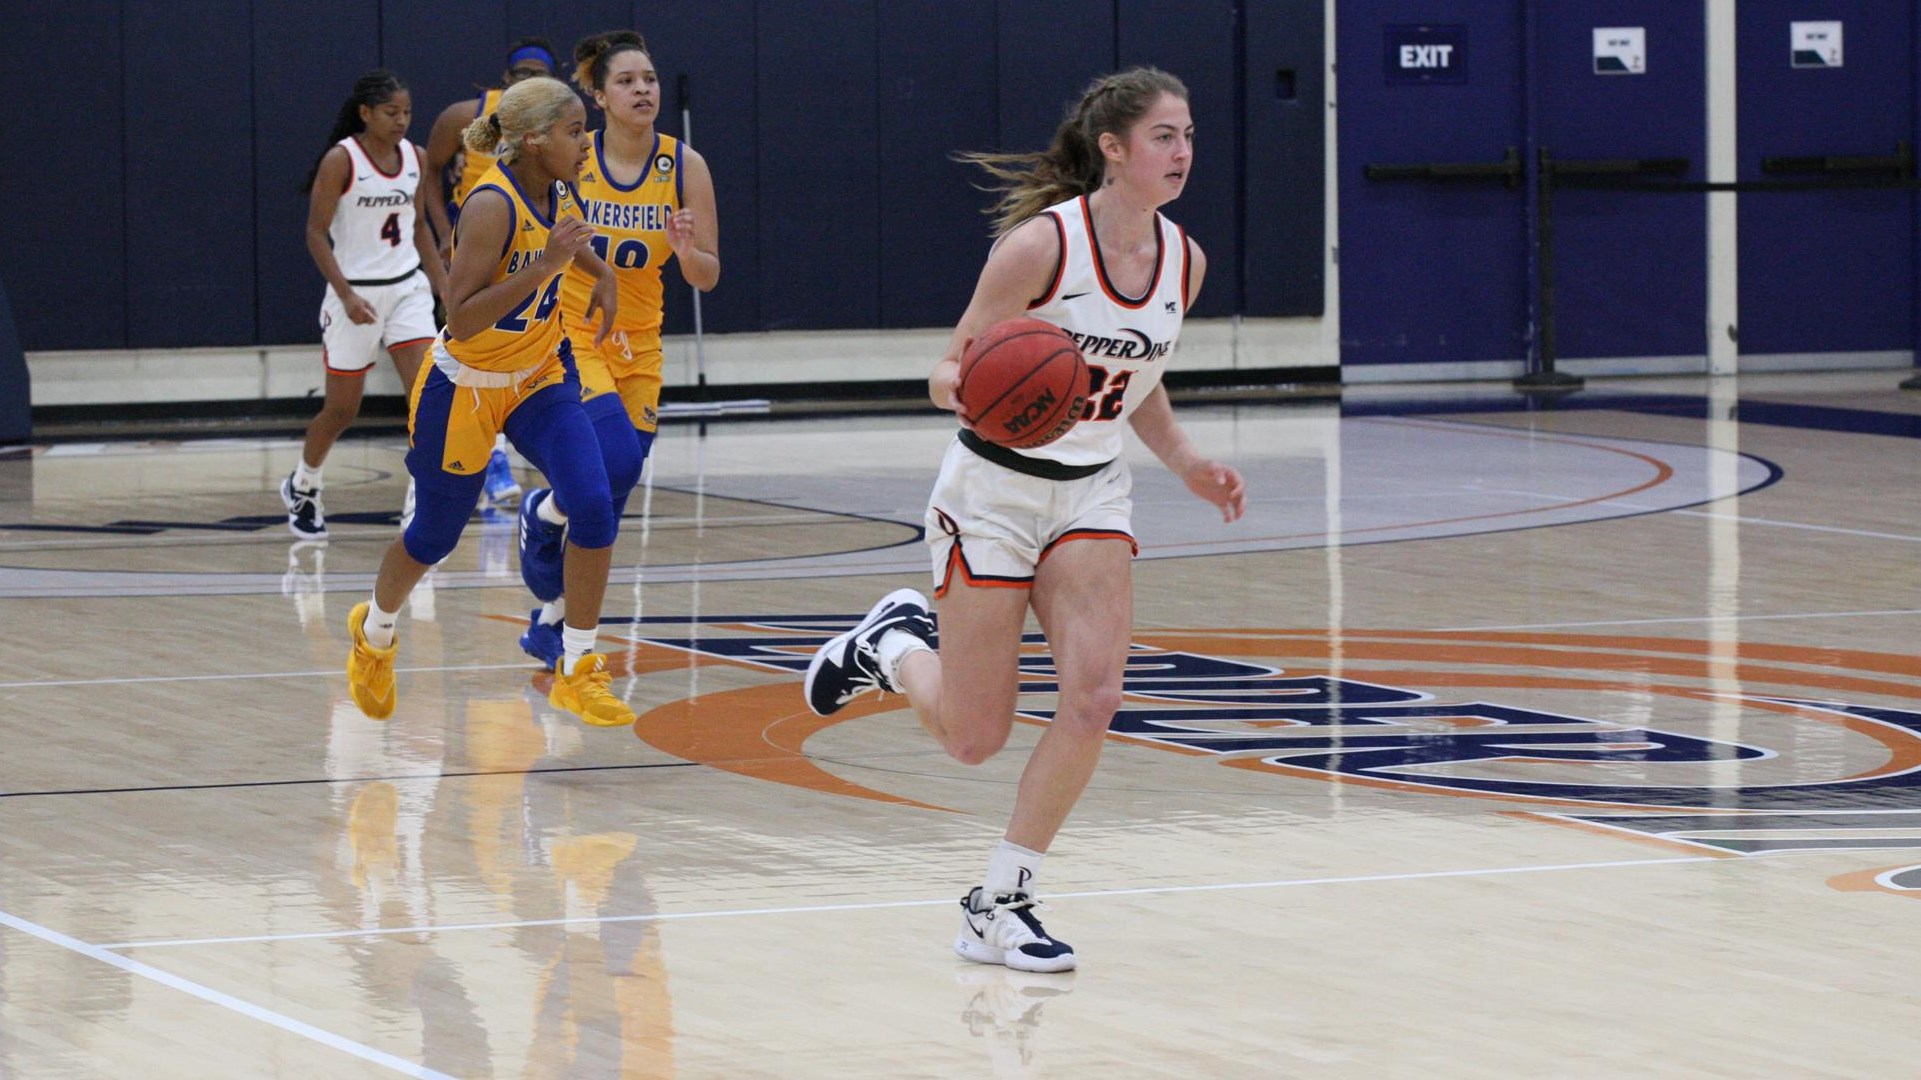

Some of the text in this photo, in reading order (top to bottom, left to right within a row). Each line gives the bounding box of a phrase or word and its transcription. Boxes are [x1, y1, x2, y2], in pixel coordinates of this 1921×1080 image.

[1400, 44, 1454, 68] EXIT
[356, 189, 414, 208] PEPPERD
[582, 198, 673, 231] AKERSFIELD
[380, 211, 402, 248] 4
[493, 272, 564, 333] 24
[1003, 387, 1056, 434] NCAA
[1079, 364, 1137, 422] 22
